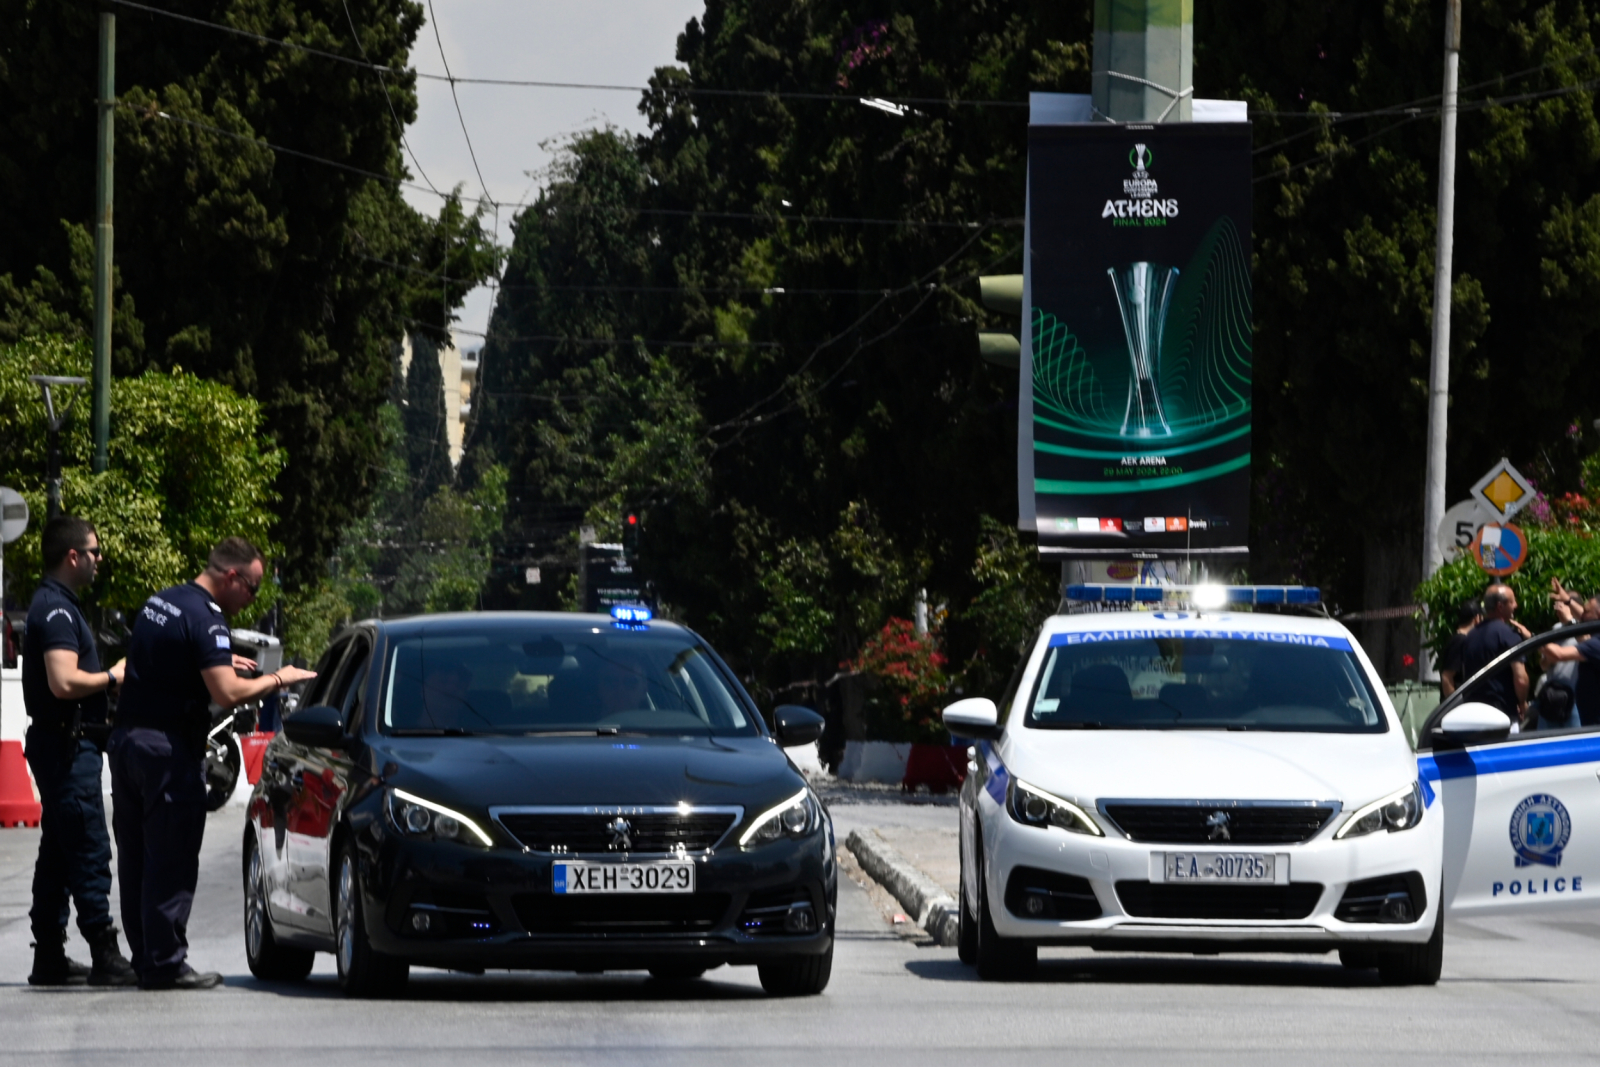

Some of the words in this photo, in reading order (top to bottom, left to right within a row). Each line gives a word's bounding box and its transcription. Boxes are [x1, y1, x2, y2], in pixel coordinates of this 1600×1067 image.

[1123, 179, 1157, 188] EUROPA
[1102, 199, 1179, 218] ATHENS
[1113, 218, 1141, 227] FINAL
[1144, 217, 1167, 226] 2024
[1121, 456, 1138, 466] AEK
[1140, 456, 1167, 466] ARENA
[1116, 467, 1134, 476] MAY
[1455, 521, 1484, 548] 5
[142, 606, 168, 627] POLICE
[1492, 876, 1582, 897] POLICE
